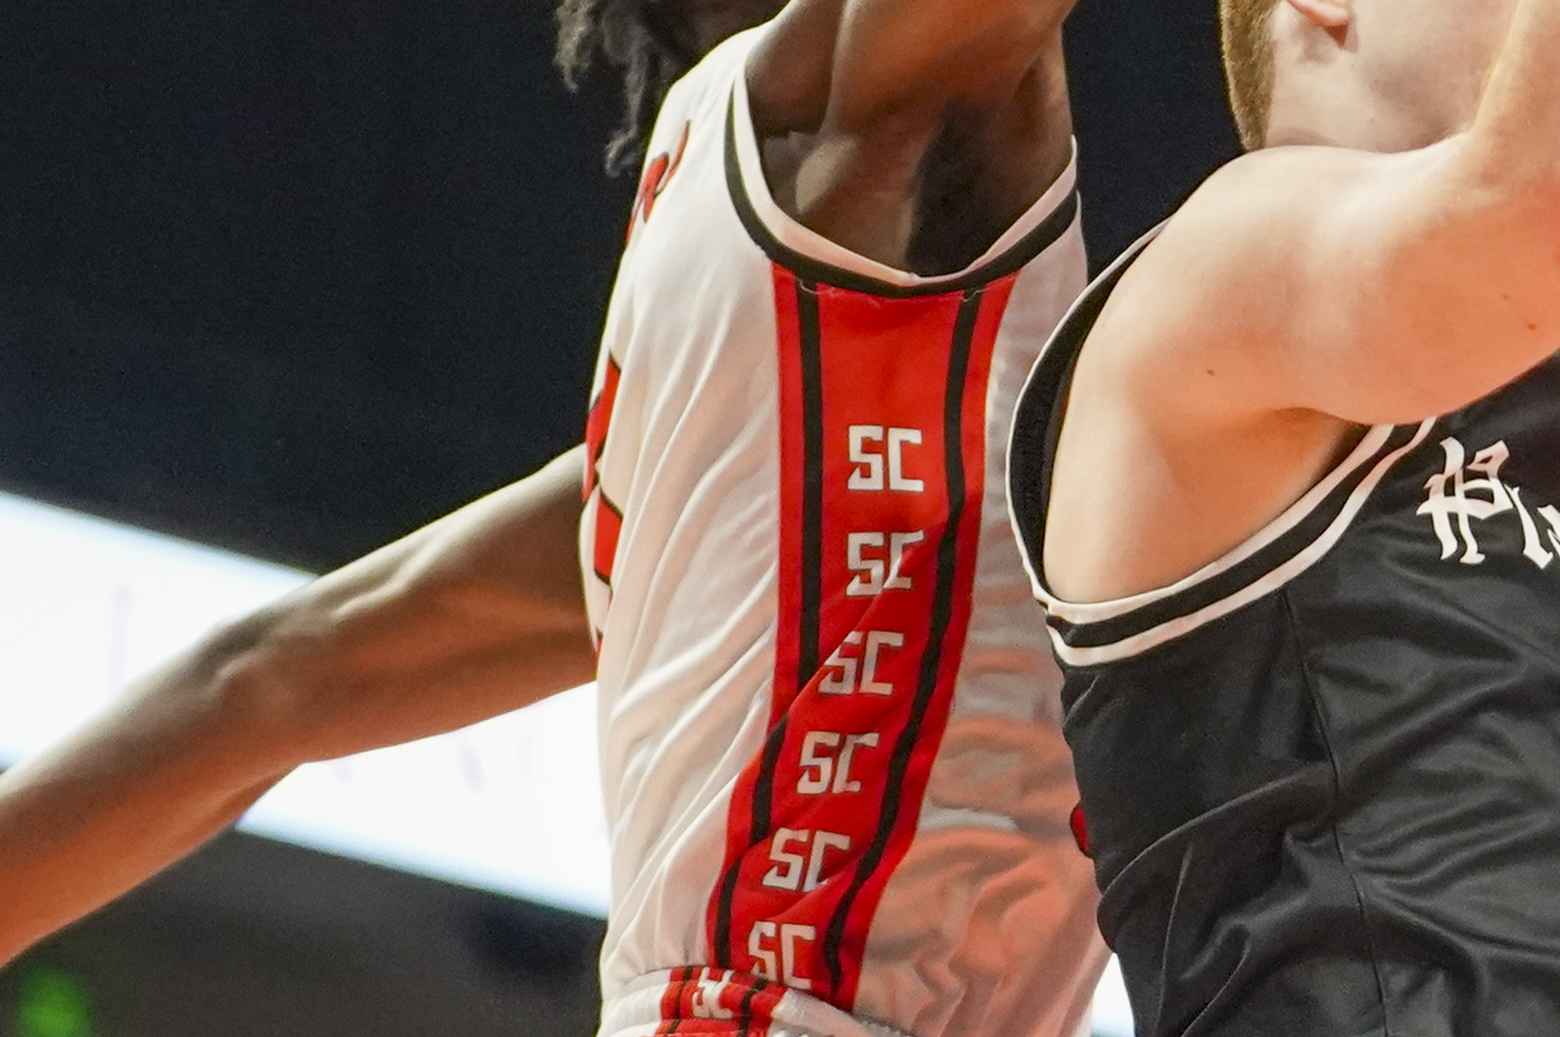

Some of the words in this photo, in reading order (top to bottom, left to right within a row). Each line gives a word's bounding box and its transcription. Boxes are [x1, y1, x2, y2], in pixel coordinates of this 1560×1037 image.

[847, 424, 925, 493] SC
[845, 530, 924, 597] SC
[818, 629, 905, 696] SC
[796, 730, 880, 795] SC
[761, 826, 851, 893] SC
[747, 920, 817, 990] SC
